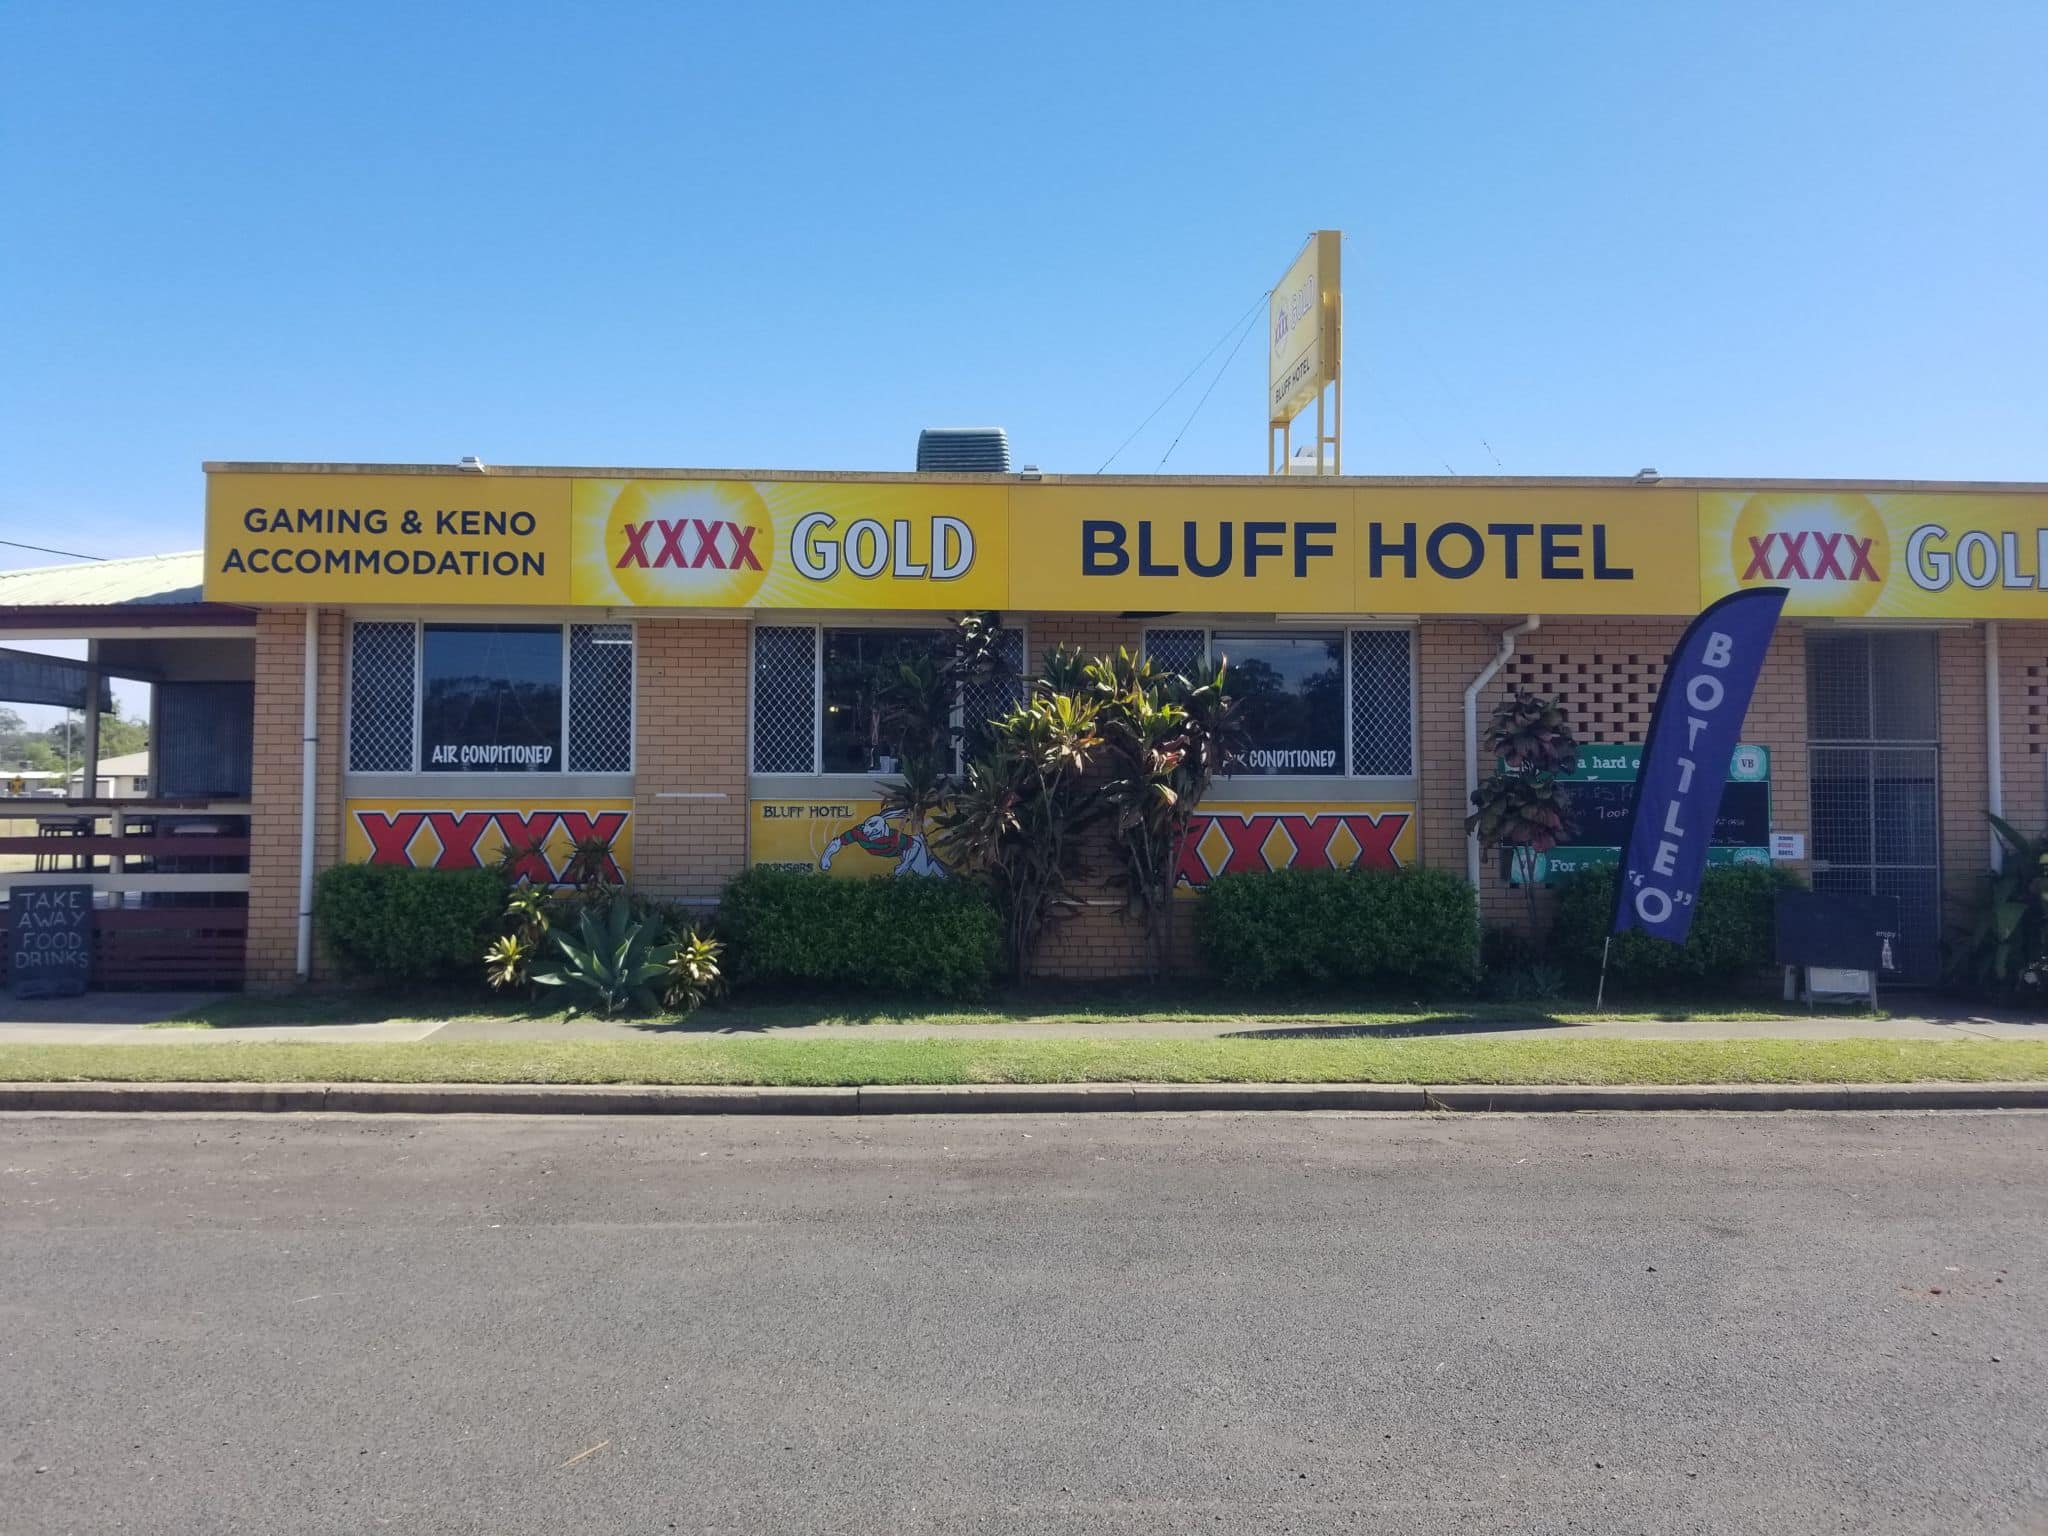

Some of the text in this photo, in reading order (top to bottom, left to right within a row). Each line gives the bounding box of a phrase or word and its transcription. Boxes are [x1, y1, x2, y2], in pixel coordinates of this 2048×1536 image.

[1275, 357, 1311, 404] BLUFF HOTEL
[243, 507, 537, 536] GAMING & KENO
[615, 511, 976, 582] XXXX GOLD
[1082, 519, 1634, 580] BLUFF HOTEL
[221, 547, 545, 576] ACCOMMODATION
[1741, 523, 2048, 593] XXXX GOL
[431, 744, 553, 764] AIR CONDITIONED
[1250, 749, 1336, 768] CONDITIONED
[1577, 759, 1587, 769] a
[1592, 756, 1627, 769] hard
[1652, 631, 1734, 877] BOTTLE
[1740, 758, 1754, 769] VB
[762, 805, 854, 818] BLUFF HOTEL
[352, 810, 633, 888] XXXX
[1550, 859, 1576, 873] For
[18, 890, 82, 911] TAKE
[18, 911, 86, 929] AWAY
[23, 931, 82, 950] FOOD
[15, 951, 89, 969] DRINKS
